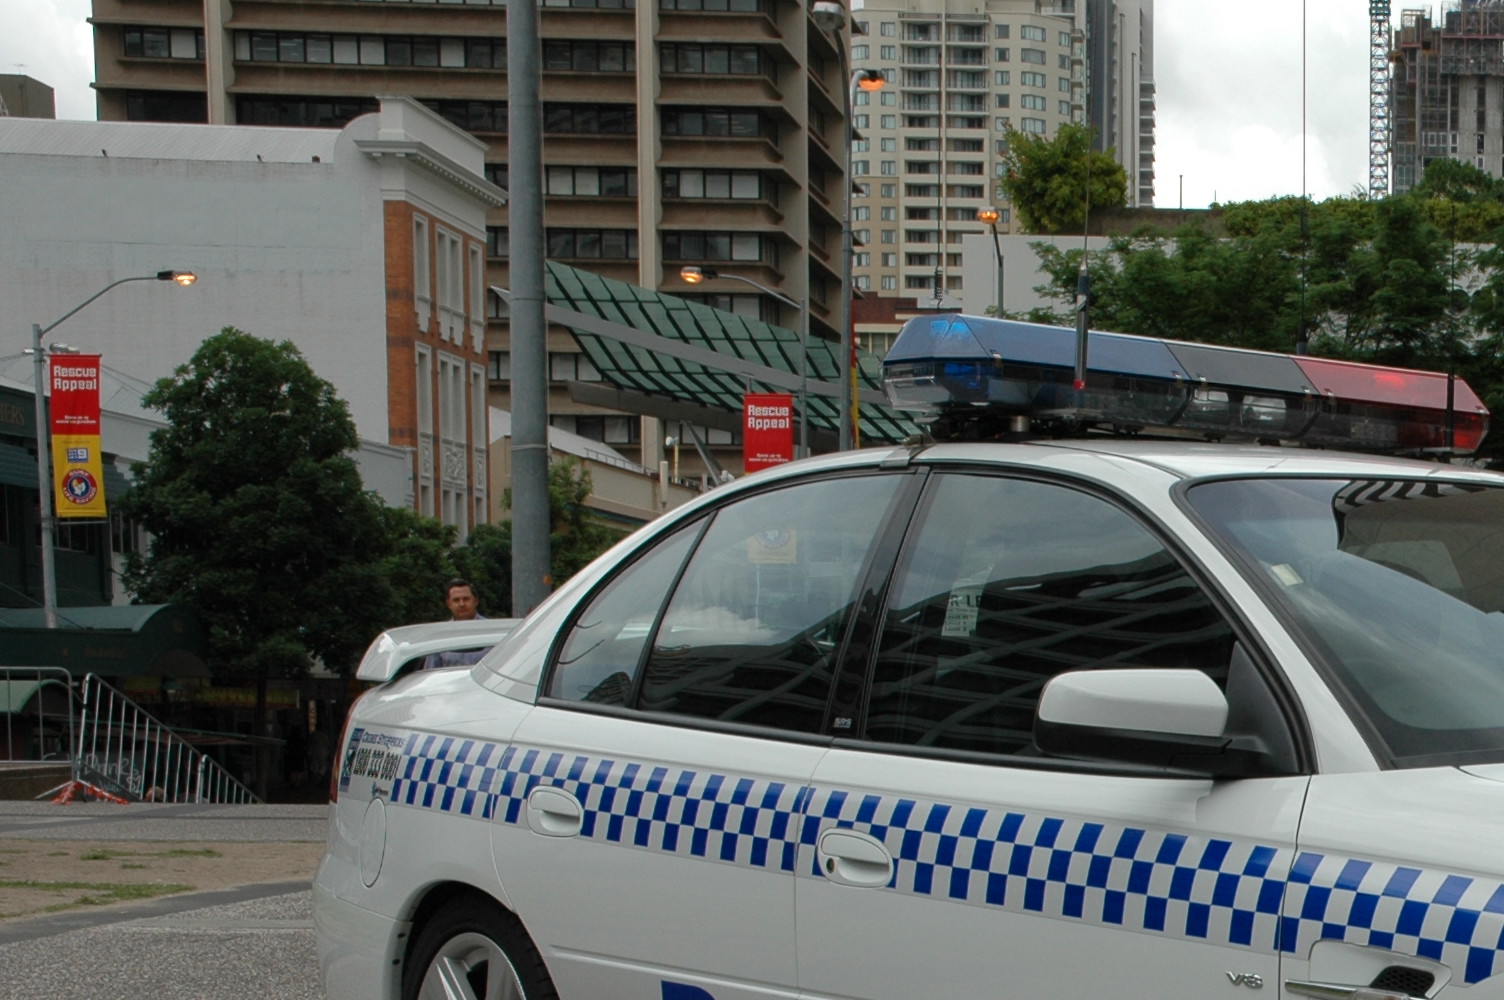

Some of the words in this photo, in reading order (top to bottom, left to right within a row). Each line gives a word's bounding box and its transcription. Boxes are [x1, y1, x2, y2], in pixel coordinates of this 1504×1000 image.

[53, 365, 96, 377] Rescue
[53, 378, 96, 391] Appeal
[748, 405, 789, 416] Rescue
[748, 417, 789, 430] Appeal
